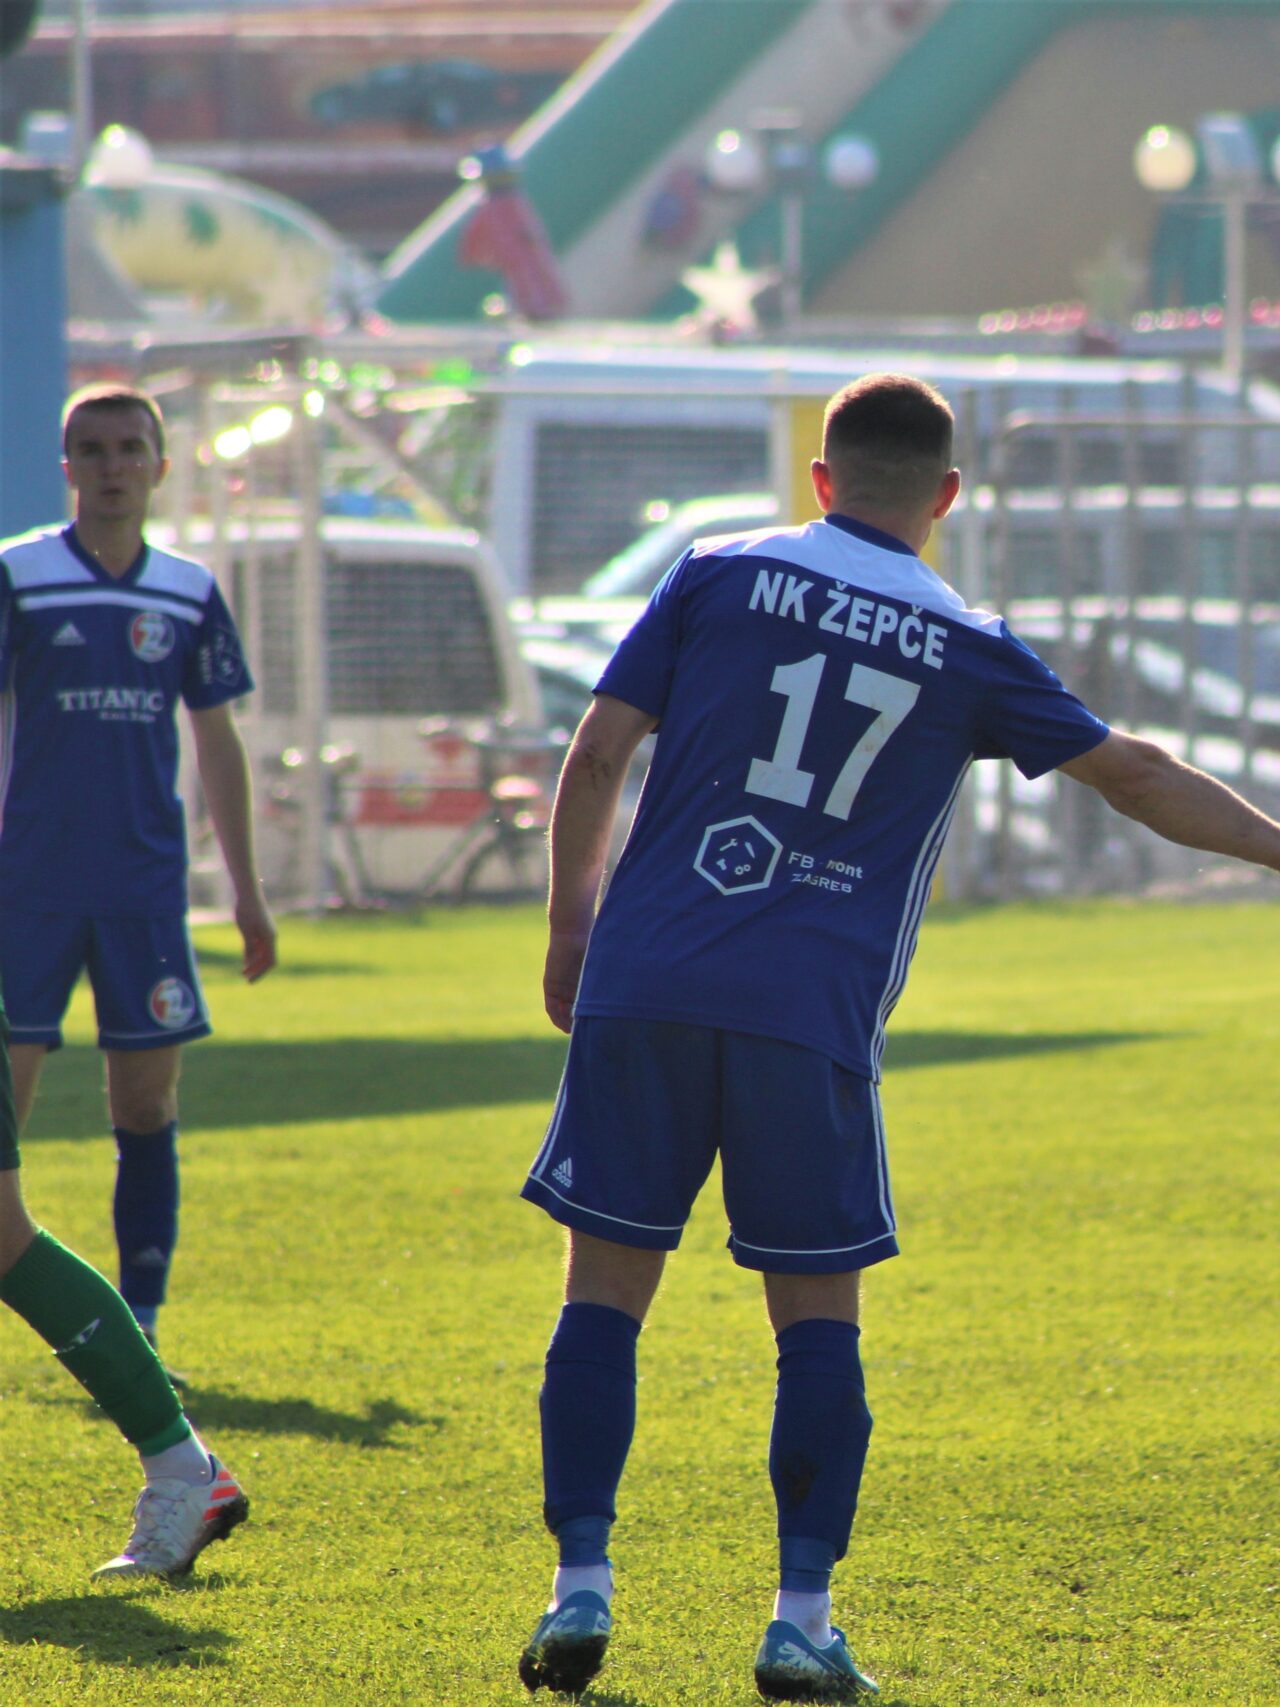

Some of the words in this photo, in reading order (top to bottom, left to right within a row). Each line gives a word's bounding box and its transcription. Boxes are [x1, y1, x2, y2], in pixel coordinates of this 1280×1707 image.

[748, 569, 815, 623] NK
[818, 580, 949, 671] ŽEPČE
[58, 687, 165, 712] TITANIC
[744, 652, 922, 822] 17
[791, 872, 853, 894] ZAGREB
